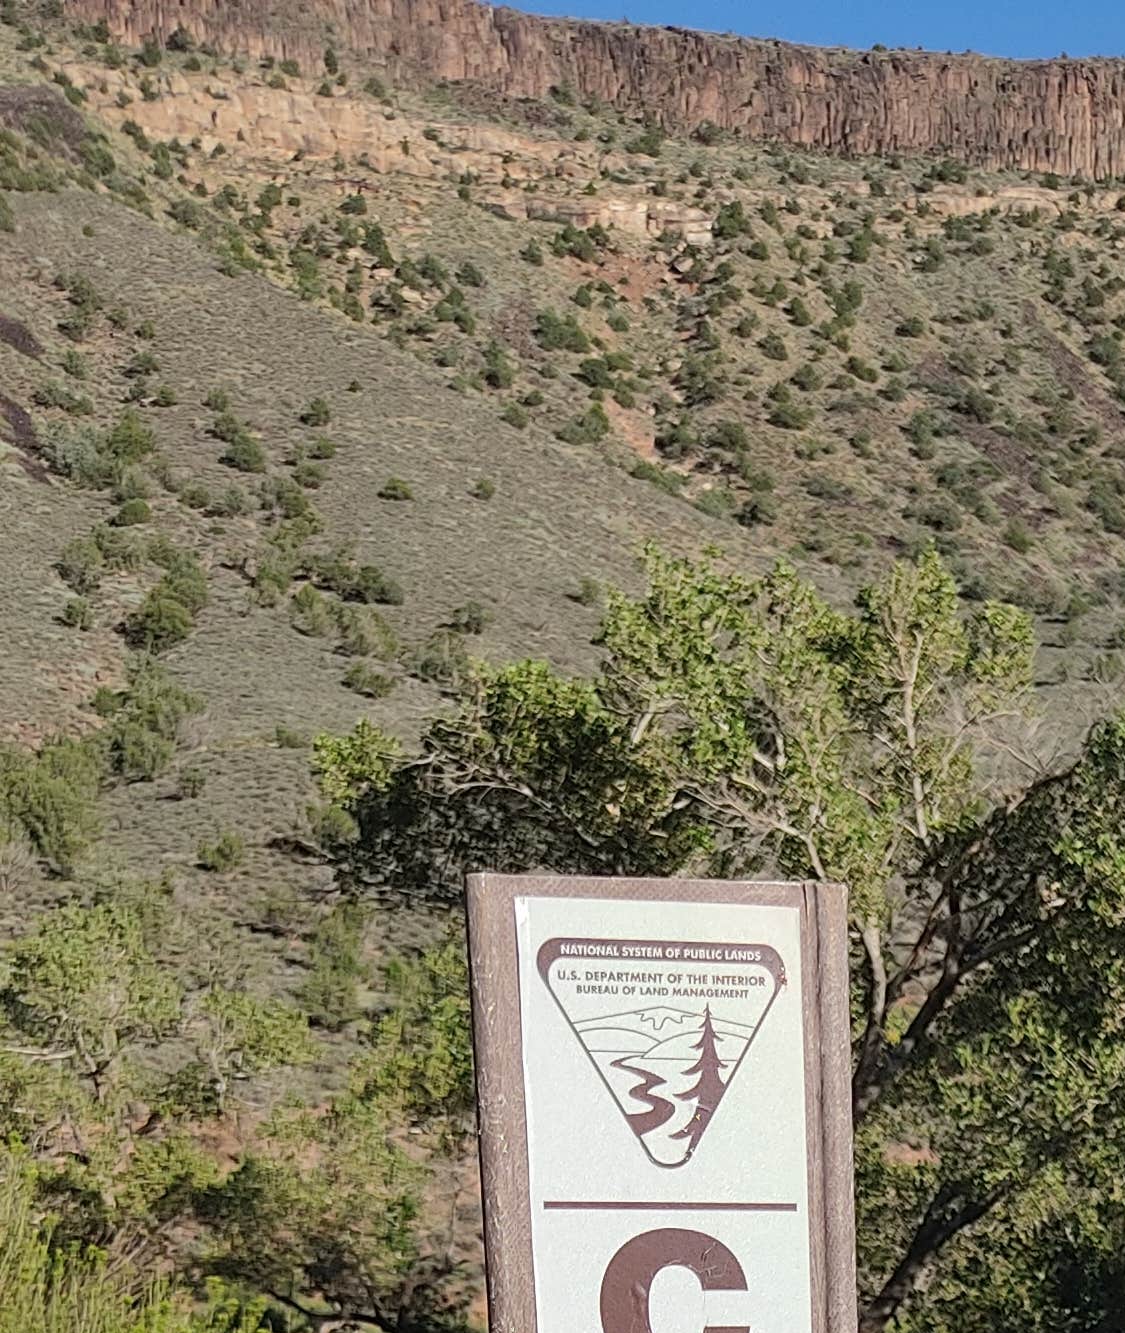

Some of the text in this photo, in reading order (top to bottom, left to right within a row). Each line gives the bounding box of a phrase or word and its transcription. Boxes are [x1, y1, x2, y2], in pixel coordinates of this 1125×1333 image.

[560, 944, 761, 962] NATIONAL SYSTEM OF PUBLIC LANDS
[557, 970, 766, 987] U.S. DEPARTMENT OF THE INTERIOR
[576, 985, 749, 999] BUREAU OF LAND MANAGEMENT
